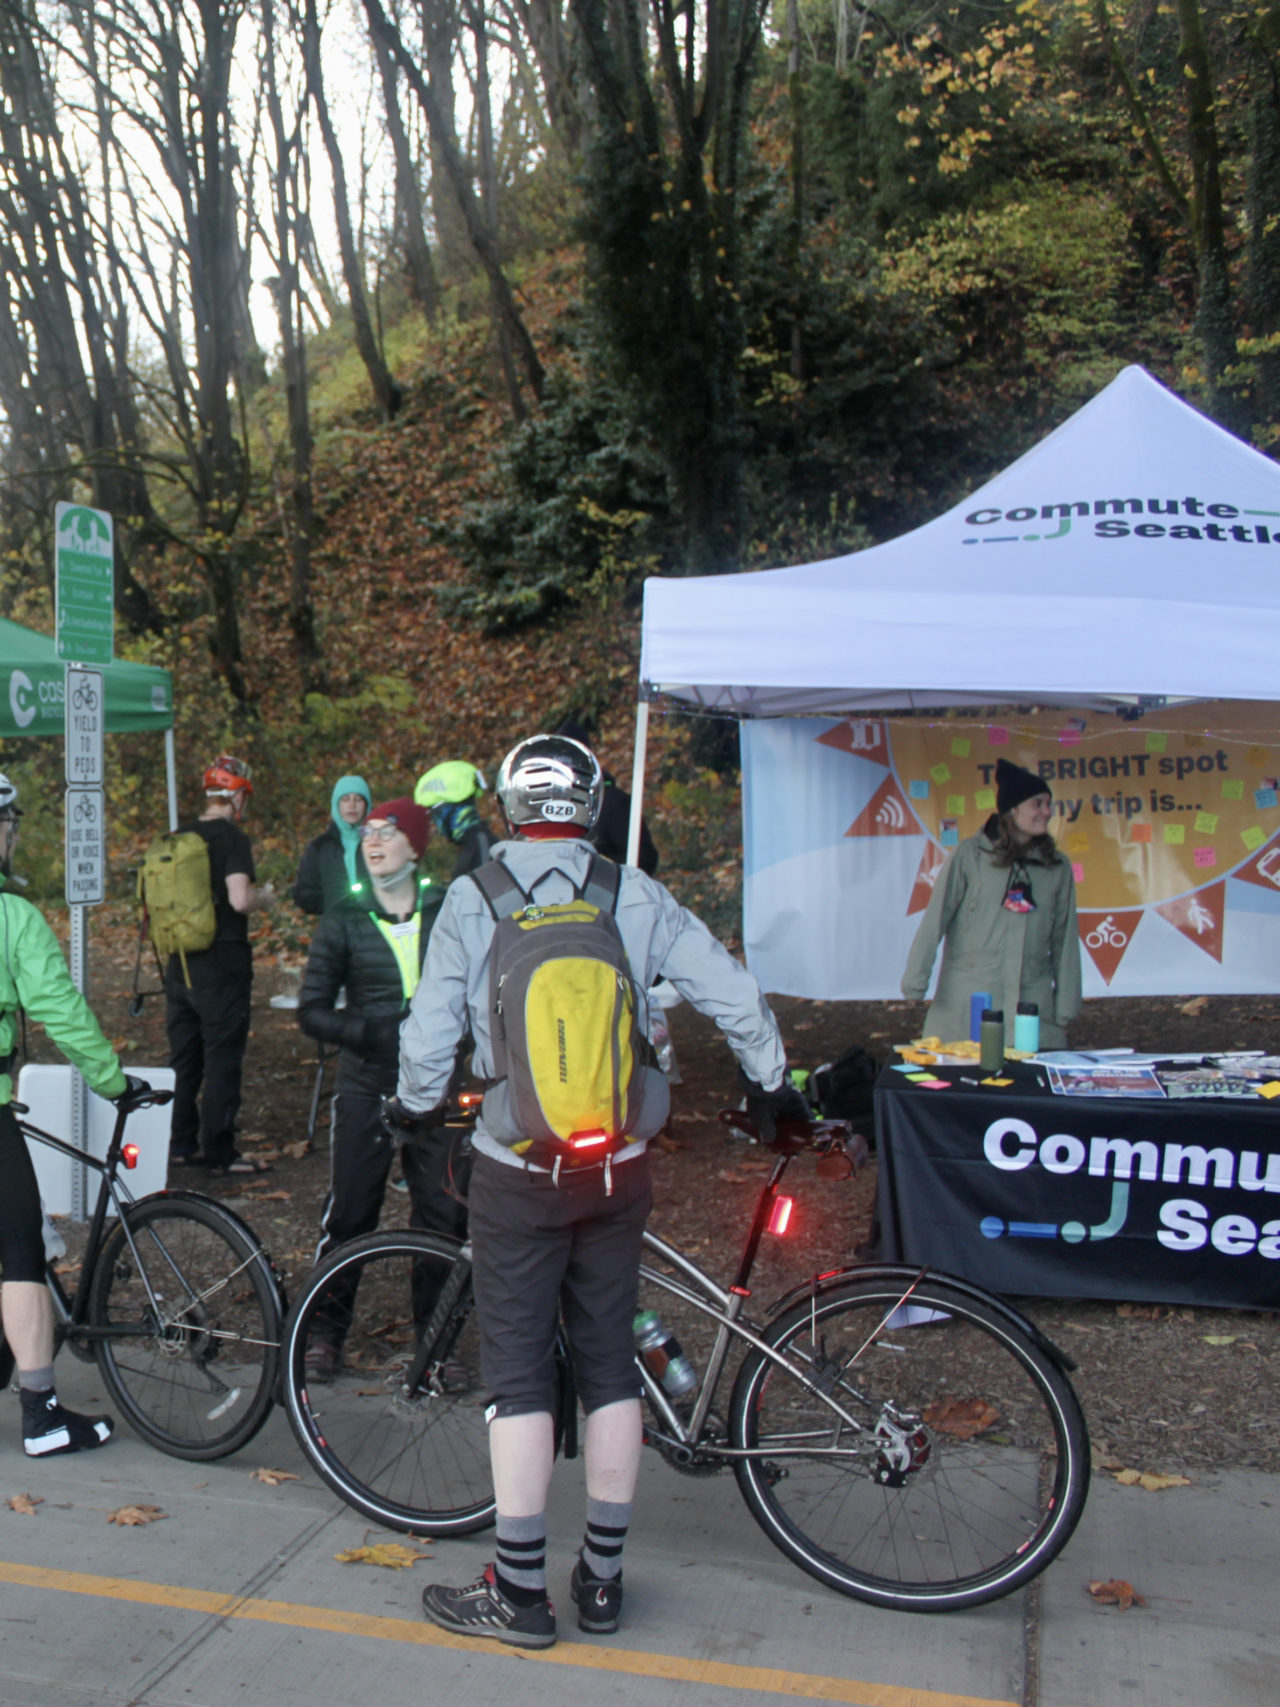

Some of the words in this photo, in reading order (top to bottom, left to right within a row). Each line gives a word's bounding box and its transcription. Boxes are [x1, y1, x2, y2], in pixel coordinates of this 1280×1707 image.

[965, 496, 1239, 526] Commute
[1094, 519, 1280, 544] Seattl
[74, 715, 97, 732] YIELD
[80, 736, 91, 752] TO
[74, 756, 96, 774] PEDS
[1038, 755, 1150, 782] BRIGHT
[1158, 749, 1229, 780] spot
[1091, 791, 1142, 819] trip
[983, 1117, 1280, 1193] Commu
